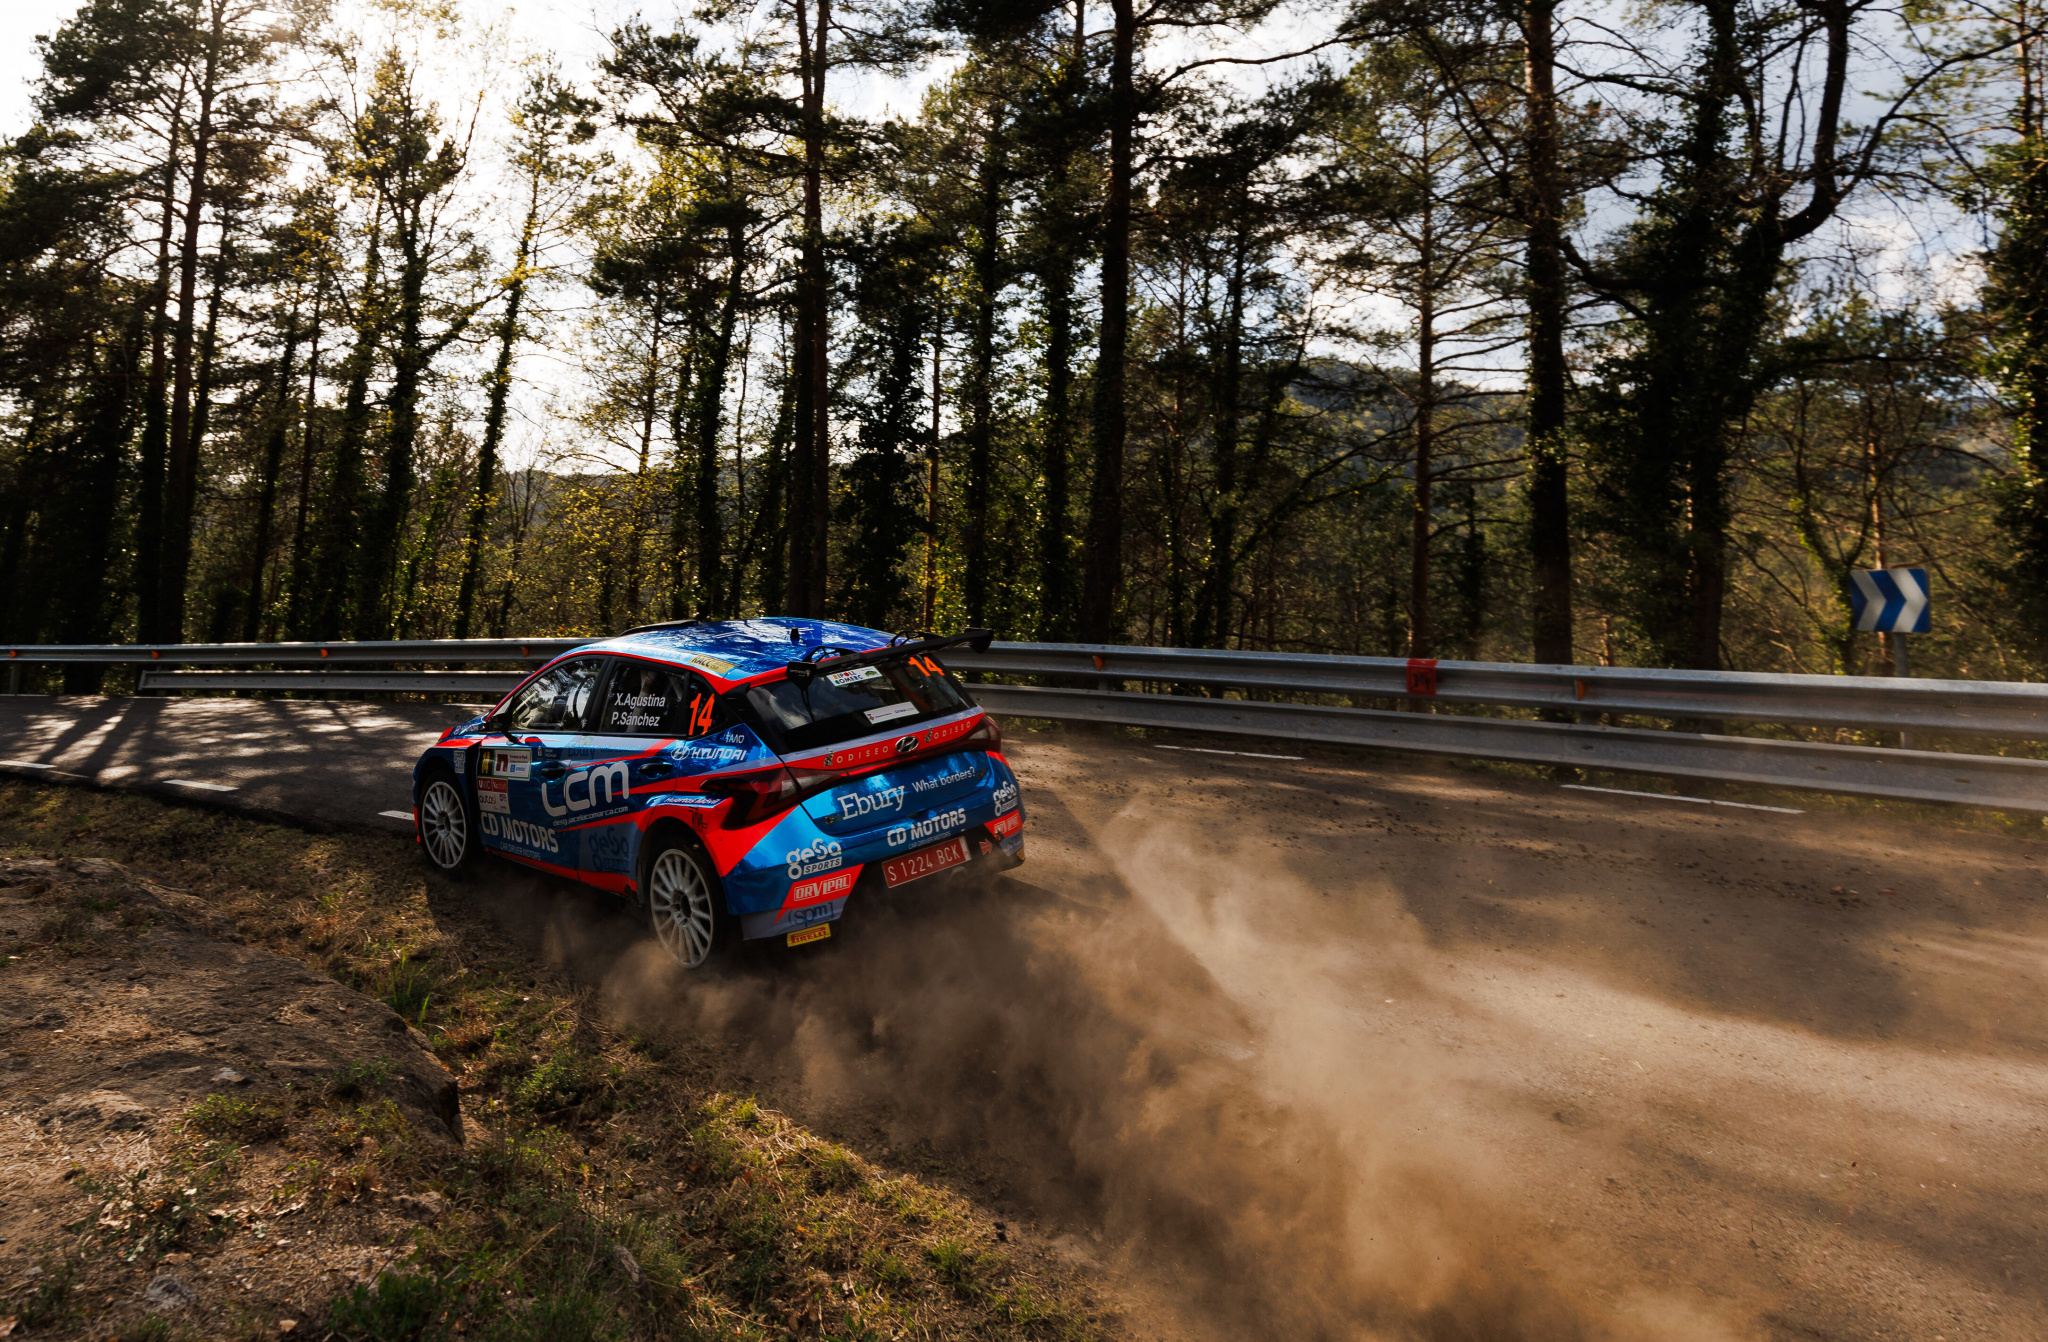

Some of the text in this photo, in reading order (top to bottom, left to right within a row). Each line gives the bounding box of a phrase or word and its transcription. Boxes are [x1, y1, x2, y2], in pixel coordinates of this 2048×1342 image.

[908, 656, 946, 677] 14
[614, 693, 666, 709] X.Agustina
[611, 711, 660, 727] P.Sánchez
[689, 693, 715, 735] 14
[691, 747, 747, 761] HYUNDAI
[836, 746, 889, 763] ODISEO
[912, 766, 976, 793] What borders?
[837, 785, 905, 821] Ebury
[481, 811, 559, 853] CD MOTORS
[887, 808, 967, 847] CD MOTORS
[804, 857, 842, 874] SPORTS
[887, 866, 897, 882] S
[900, 853, 933, 877] 1224
[936, 844, 961, 865] BCK
